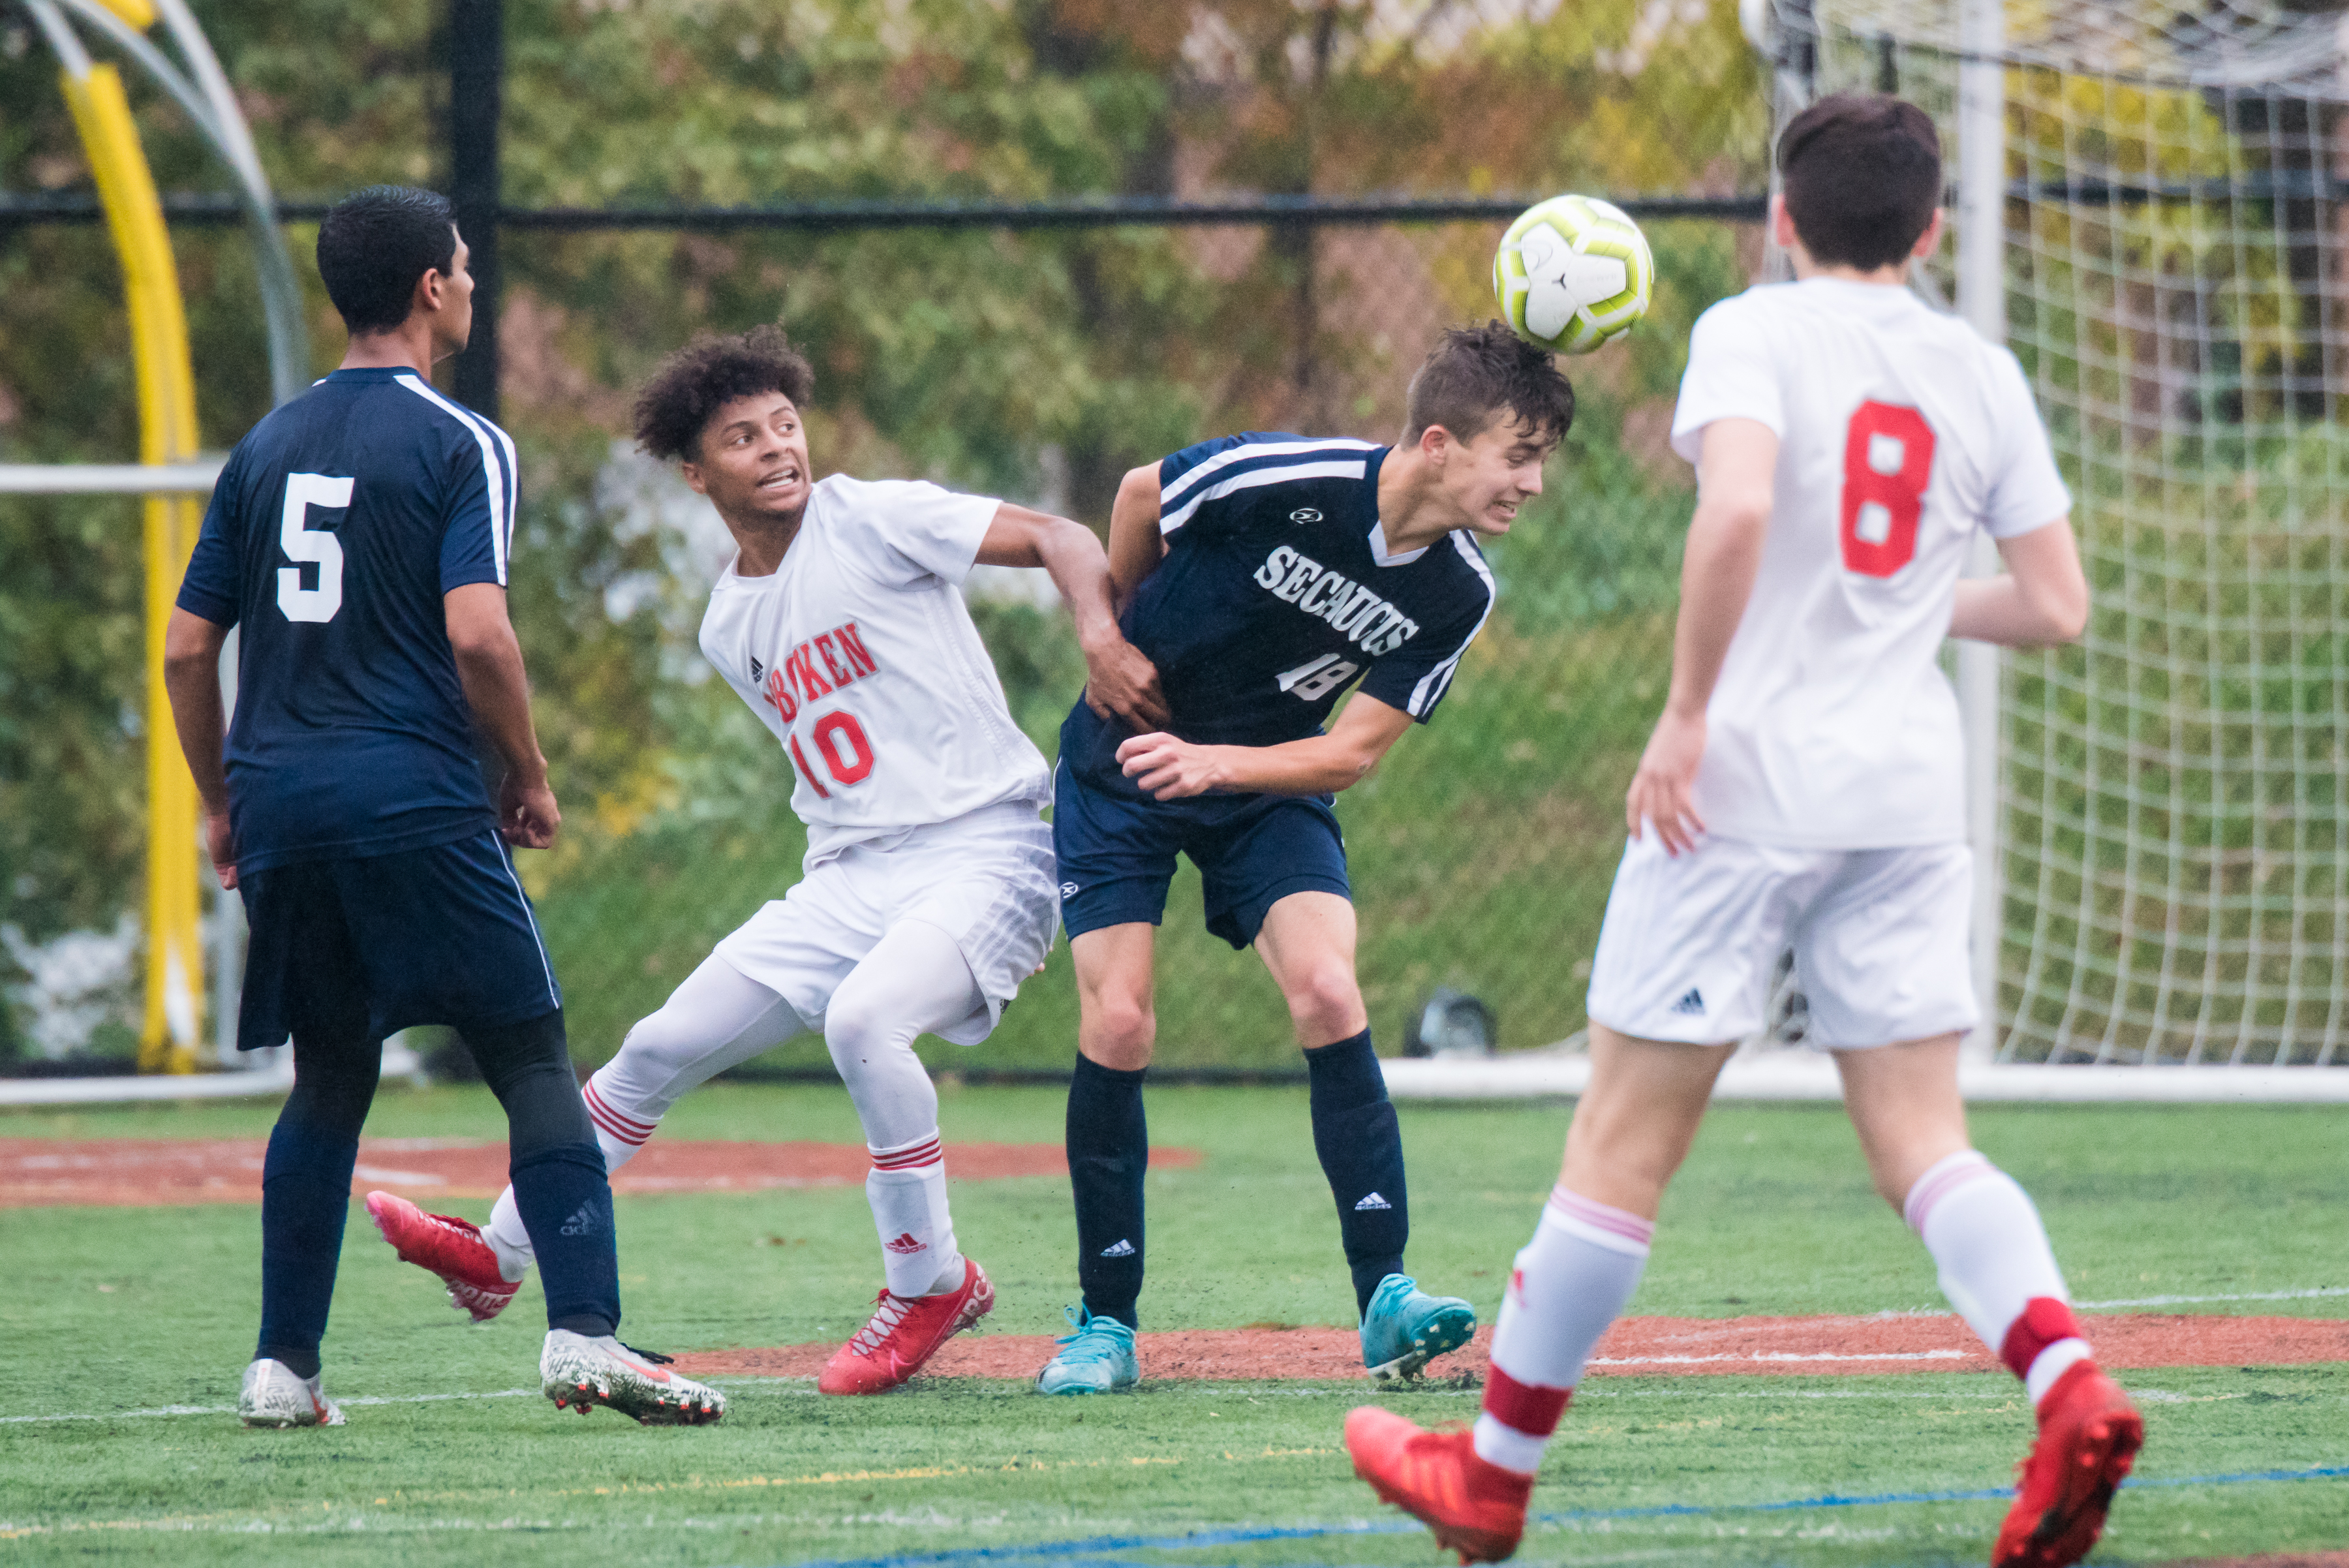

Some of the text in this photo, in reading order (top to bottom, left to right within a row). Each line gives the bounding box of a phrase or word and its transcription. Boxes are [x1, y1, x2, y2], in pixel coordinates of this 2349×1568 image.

[277, 472, 354, 623] 5
[1838, 397, 1937, 580] 8
[1275, 653, 1359, 701] 18
[790, 709, 875, 799] 10
